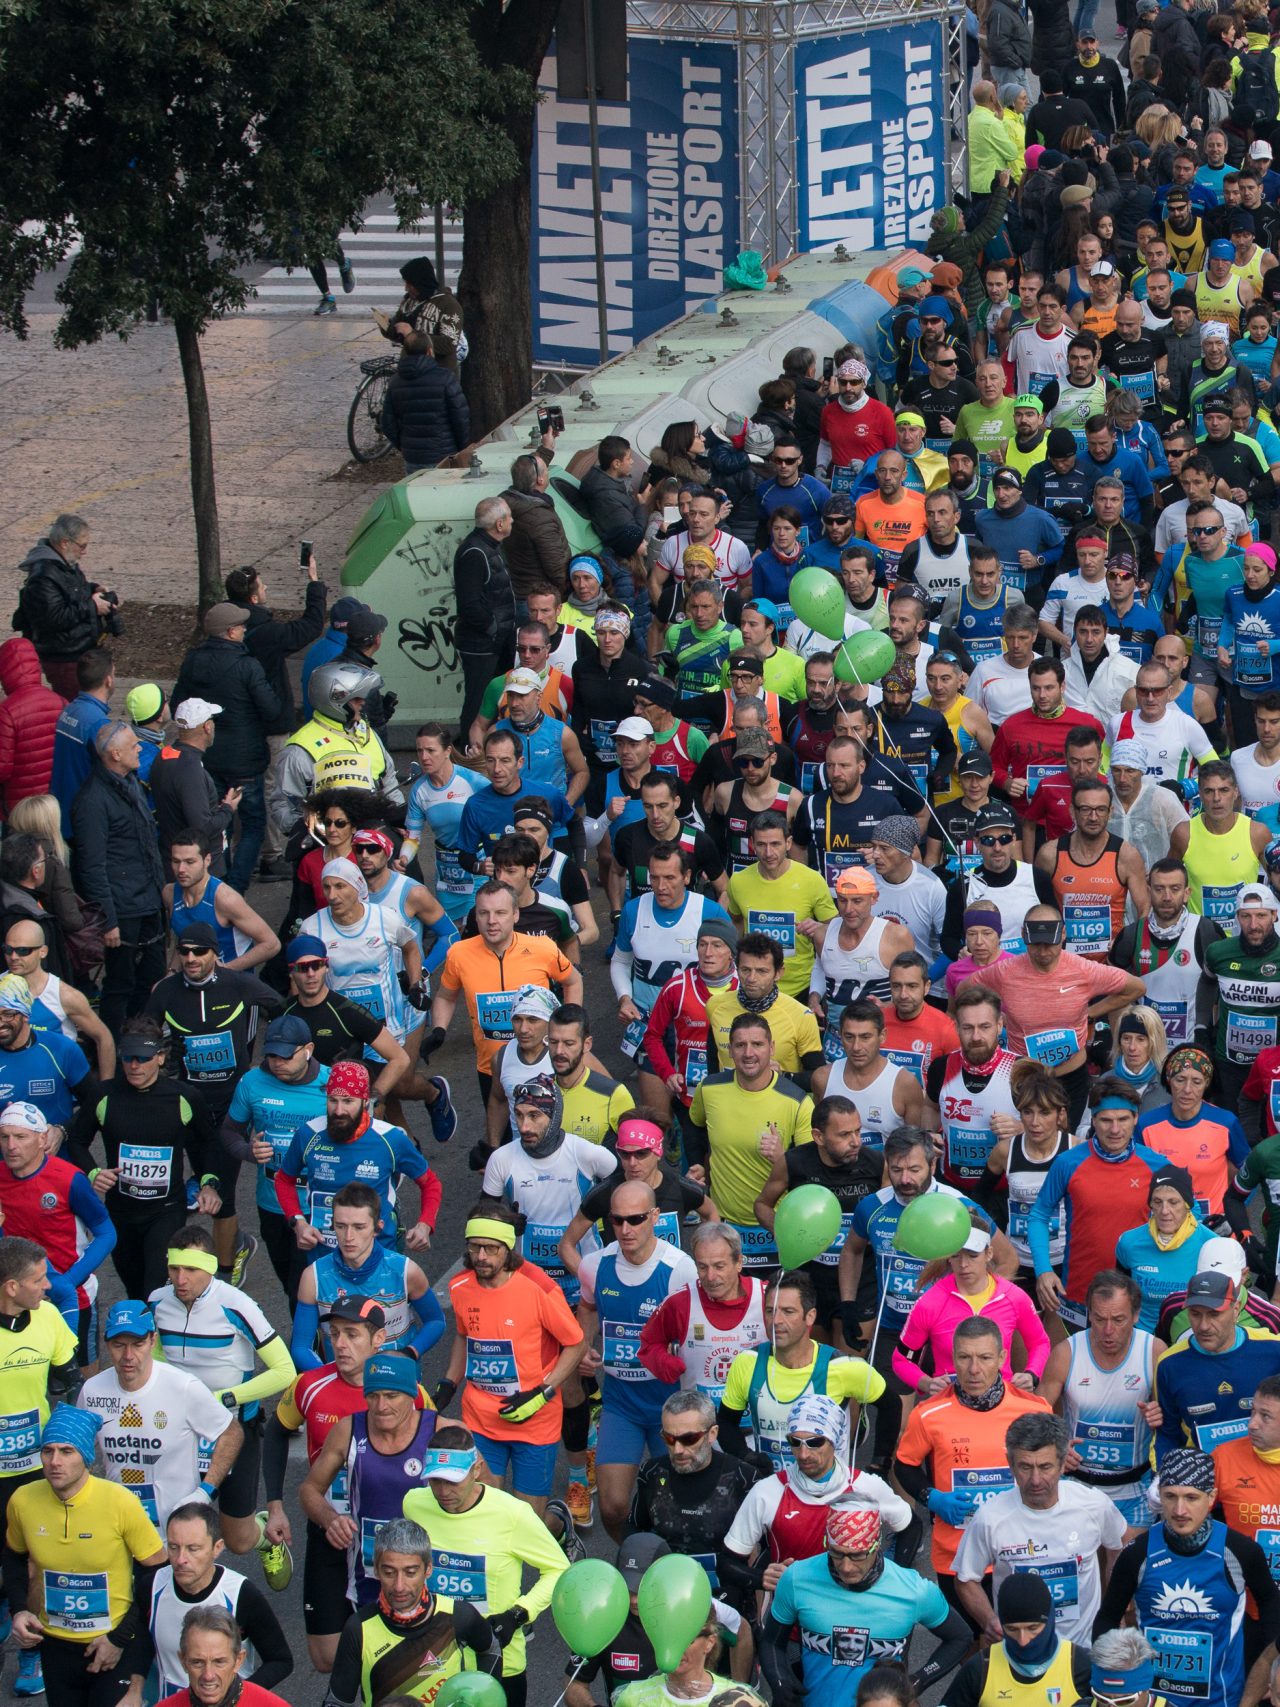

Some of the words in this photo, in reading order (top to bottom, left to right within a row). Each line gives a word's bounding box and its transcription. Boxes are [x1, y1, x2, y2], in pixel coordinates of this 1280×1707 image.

[538, 54, 633, 351] NAVETT
[646, 132, 679, 282] DIREZIONE
[324, 760, 357, 770] MOTO
[316, 774, 369, 789] STAFFETTA
[1072, 924, 1104, 935] 1169
[1075, 944, 1100, 952] Joma
[1229, 984, 1267, 995] ALPINI
[1237, 1018, 1265, 1026] Joma
[192, 1038, 221, 1047] Joma
[1037, 1034, 1064, 1044] Joma
[1232, 1034, 1271, 1046] H1498
[188, 1051, 230, 1064] H1401
[1038, 1046, 1071, 1062] H552
[957, 1131, 986, 1139] Joma
[130, 1149, 160, 1158] Joma
[122, 1163, 166, 1177] H1879
[533, 1228, 563, 1236] Joma
[473, 1361, 508, 1375] 2567
[616, 1369, 647, 1378] Joma
[480, 1385, 506, 1393] Joma
[87, 1398, 120, 1408] SARTORI
[10, 1418, 29, 1426] agsm
[1211, 1420, 1247, 1438] Joma
[104, 1436, 161, 1449] metano
[107, 1450, 140, 1463] nord
[1087, 1447, 1119, 1460] 553
[2, 1459, 31, 1469] Joma
[438, 1575, 472, 1591] 956
[65, 1596, 87, 1609] 56
[63, 1620, 94, 1628] Joma
[1158, 1635, 1196, 1645] Joma
[615, 1656, 635, 1666] müller
[1152, 1655, 1203, 1671] H1731
